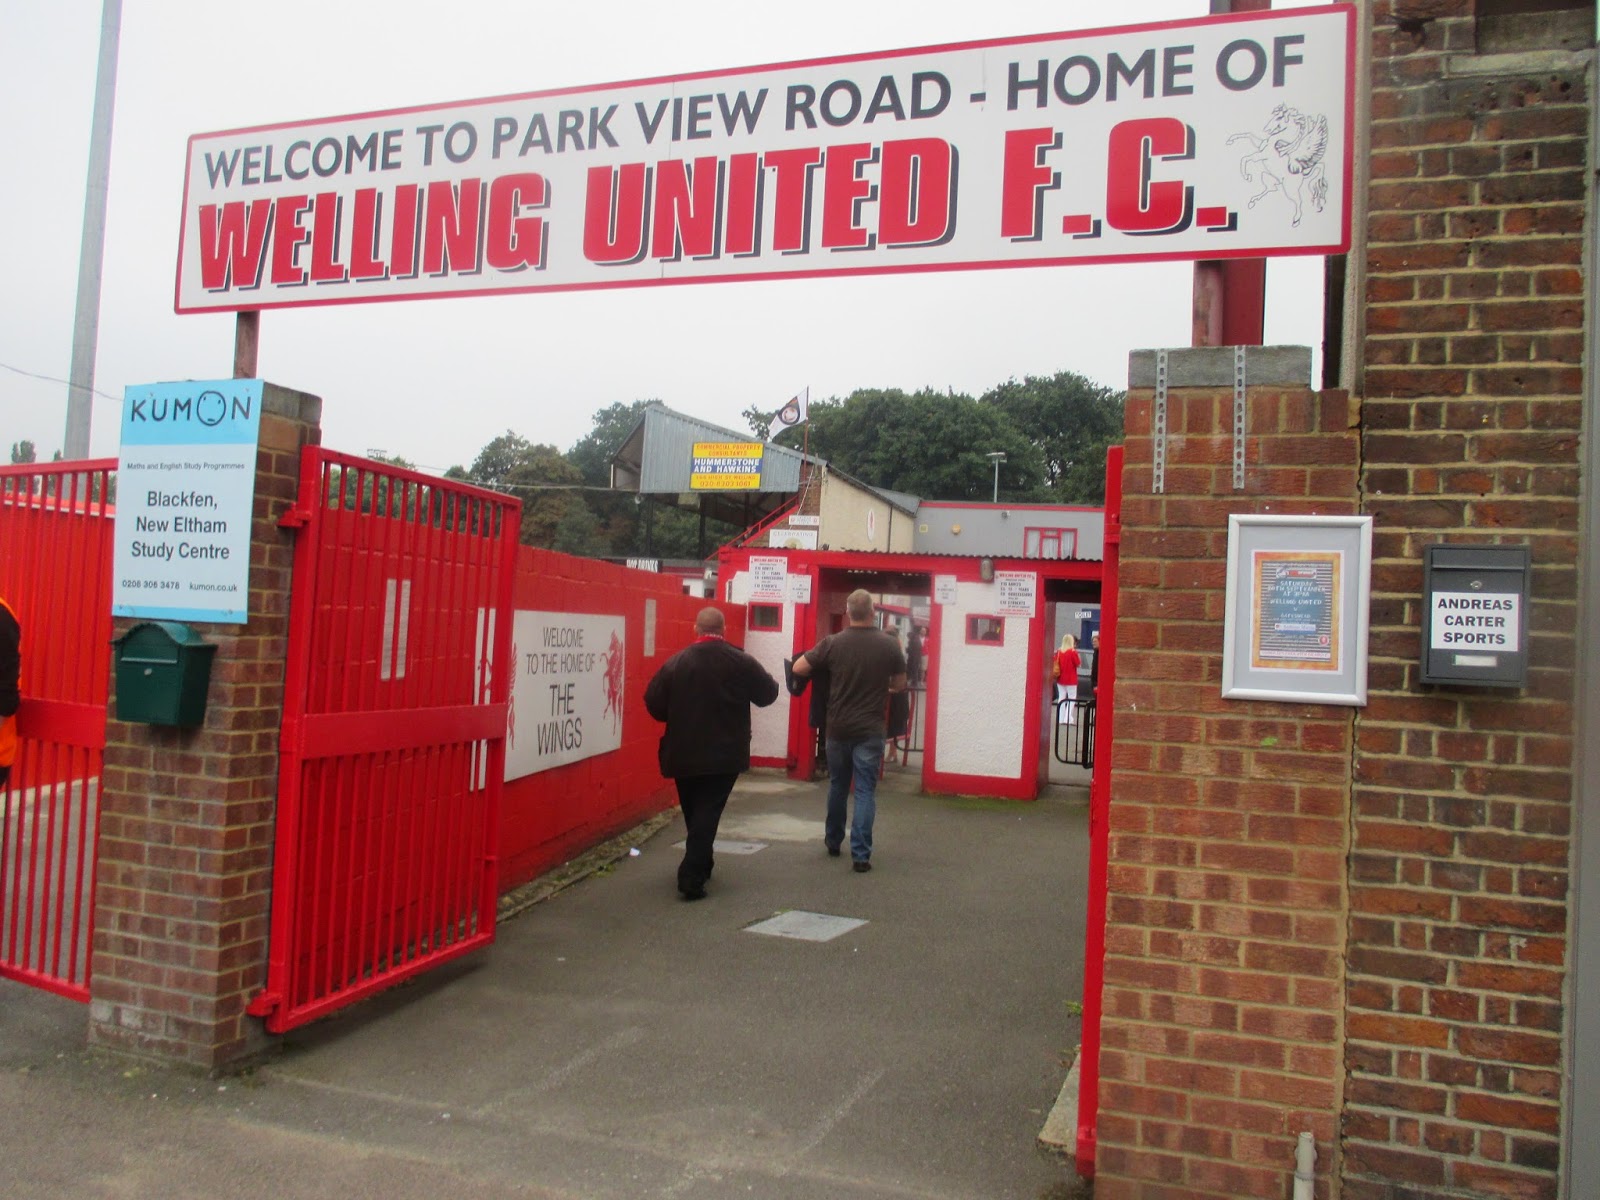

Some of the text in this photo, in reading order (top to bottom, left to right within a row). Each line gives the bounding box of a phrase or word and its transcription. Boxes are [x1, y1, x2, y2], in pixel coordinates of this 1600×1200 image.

[205, 129, 403, 190] WELCOME
[416, 121, 478, 166] TO
[492, 105, 620, 159] PARK
[635, 89, 768, 145] VIEW
[785, 71, 952, 131] ROAD
[1007, 45, 1194, 111] HOME
[1215, 34, 1305, 91] OF
[199, 117, 1238, 293] WELLING UNITED F.C.
[131, 390, 252, 426] KUMON
[160, 463, 183, 471] English
[184, 463, 202, 471] Study
[203, 463, 245, 471] Programmes
[693, 465, 757, 473] AND HAWKINS
[694, 458, 760, 466] HUMMERSTONE
[147, 491, 218, 510] Blackfen,
[136, 517, 227, 534] New Eltham
[131, 541, 230, 561] Study Centre
[189, 581, 238, 592] kumon.co.uk
[1438, 598, 1513, 611] ANDREAS
[1444, 615, 1505, 628] CARTER
[543, 627, 584, 648] WELCOME
[1443, 632, 1506, 645] SPORTS
[526, 653, 596, 675] TO THE HOME OF
[550, 683, 575, 717] THE
[537, 717, 583, 756] WINGS
